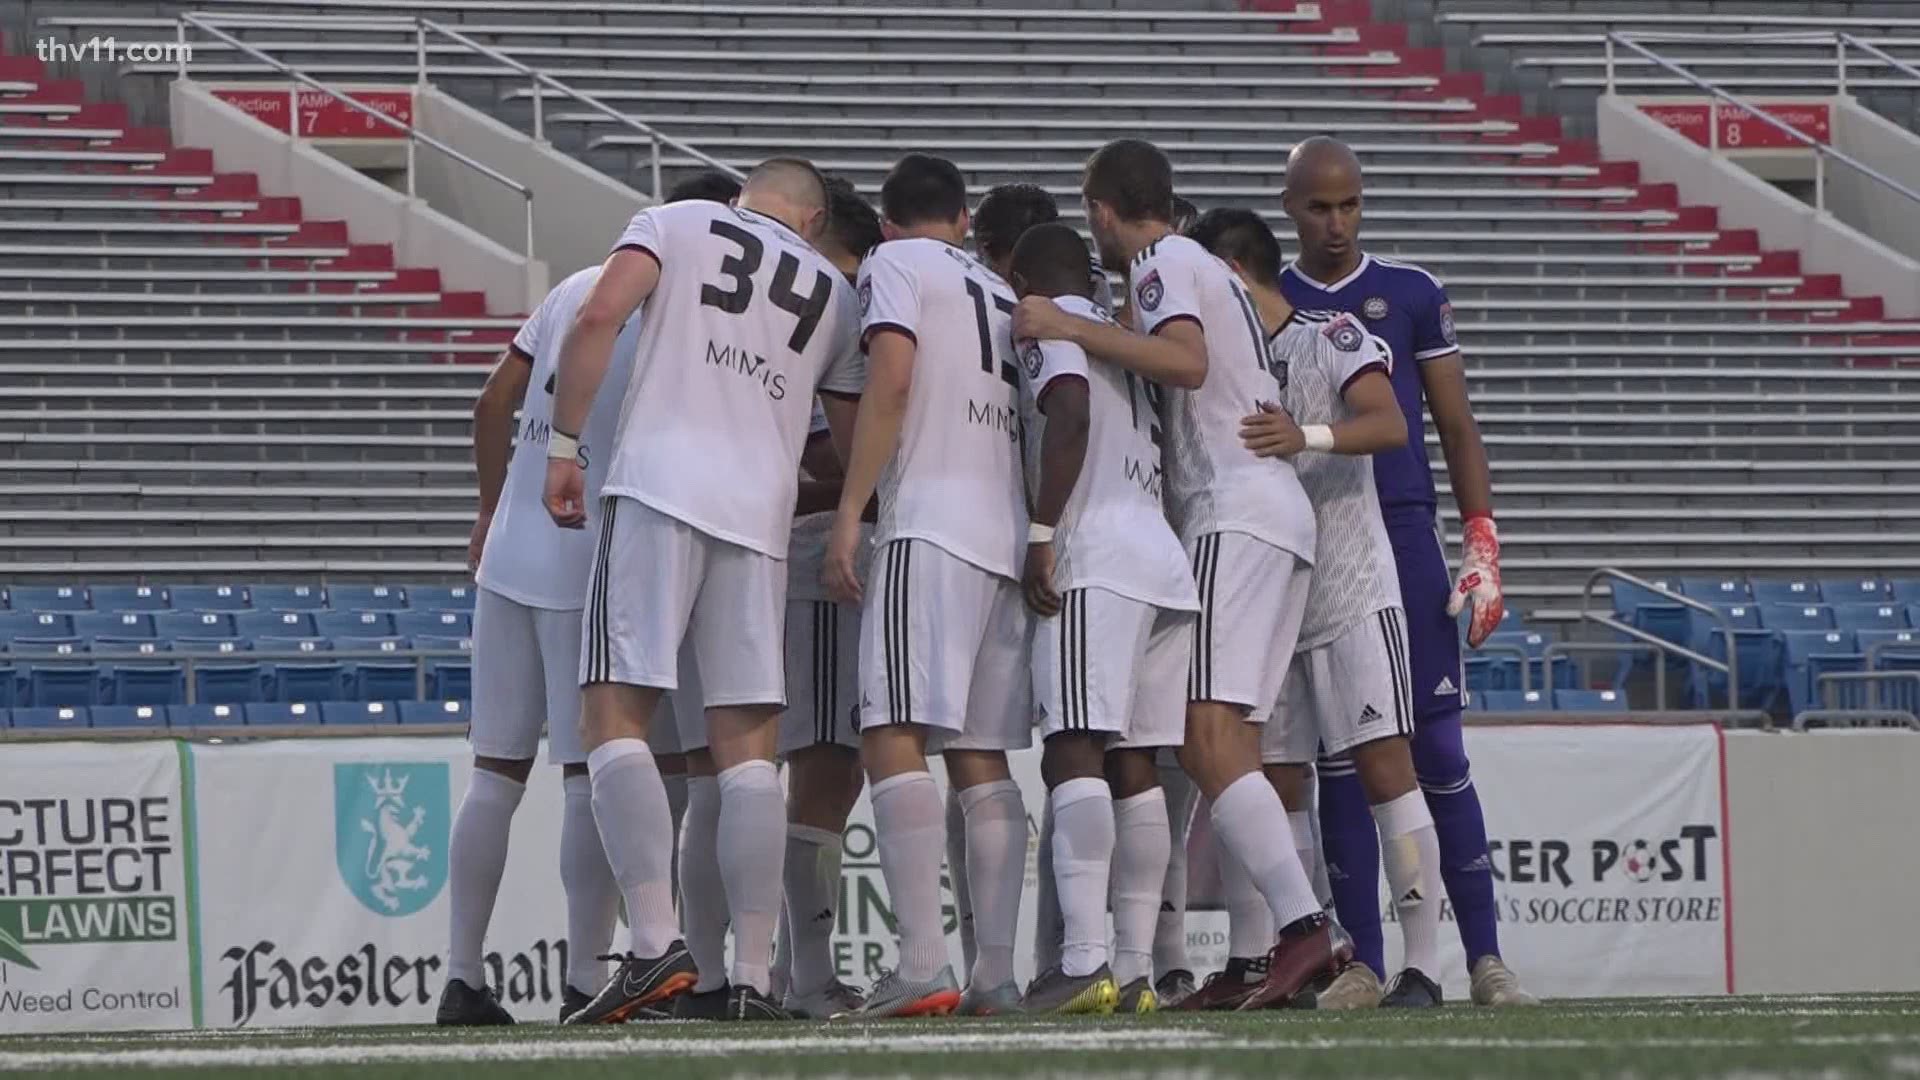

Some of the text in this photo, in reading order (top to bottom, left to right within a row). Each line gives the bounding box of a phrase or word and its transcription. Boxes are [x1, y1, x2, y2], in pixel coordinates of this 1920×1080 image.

[298, 93, 333, 107] AMP
[304, 111, 318, 133] 7
[1727, 123, 1741, 146] 8
[700, 219, 833, 355] 34
[0, 847, 172, 896] RFECT
[20, 902, 173, 940] LAWNS
[1526, 897, 1630, 924] SOCCER
[1634, 897, 1722, 923] STORE
[219, 939, 442, 1029] Fassler
[0, 987, 72, 1013] Weed
[82, 985, 180, 1011] Control
